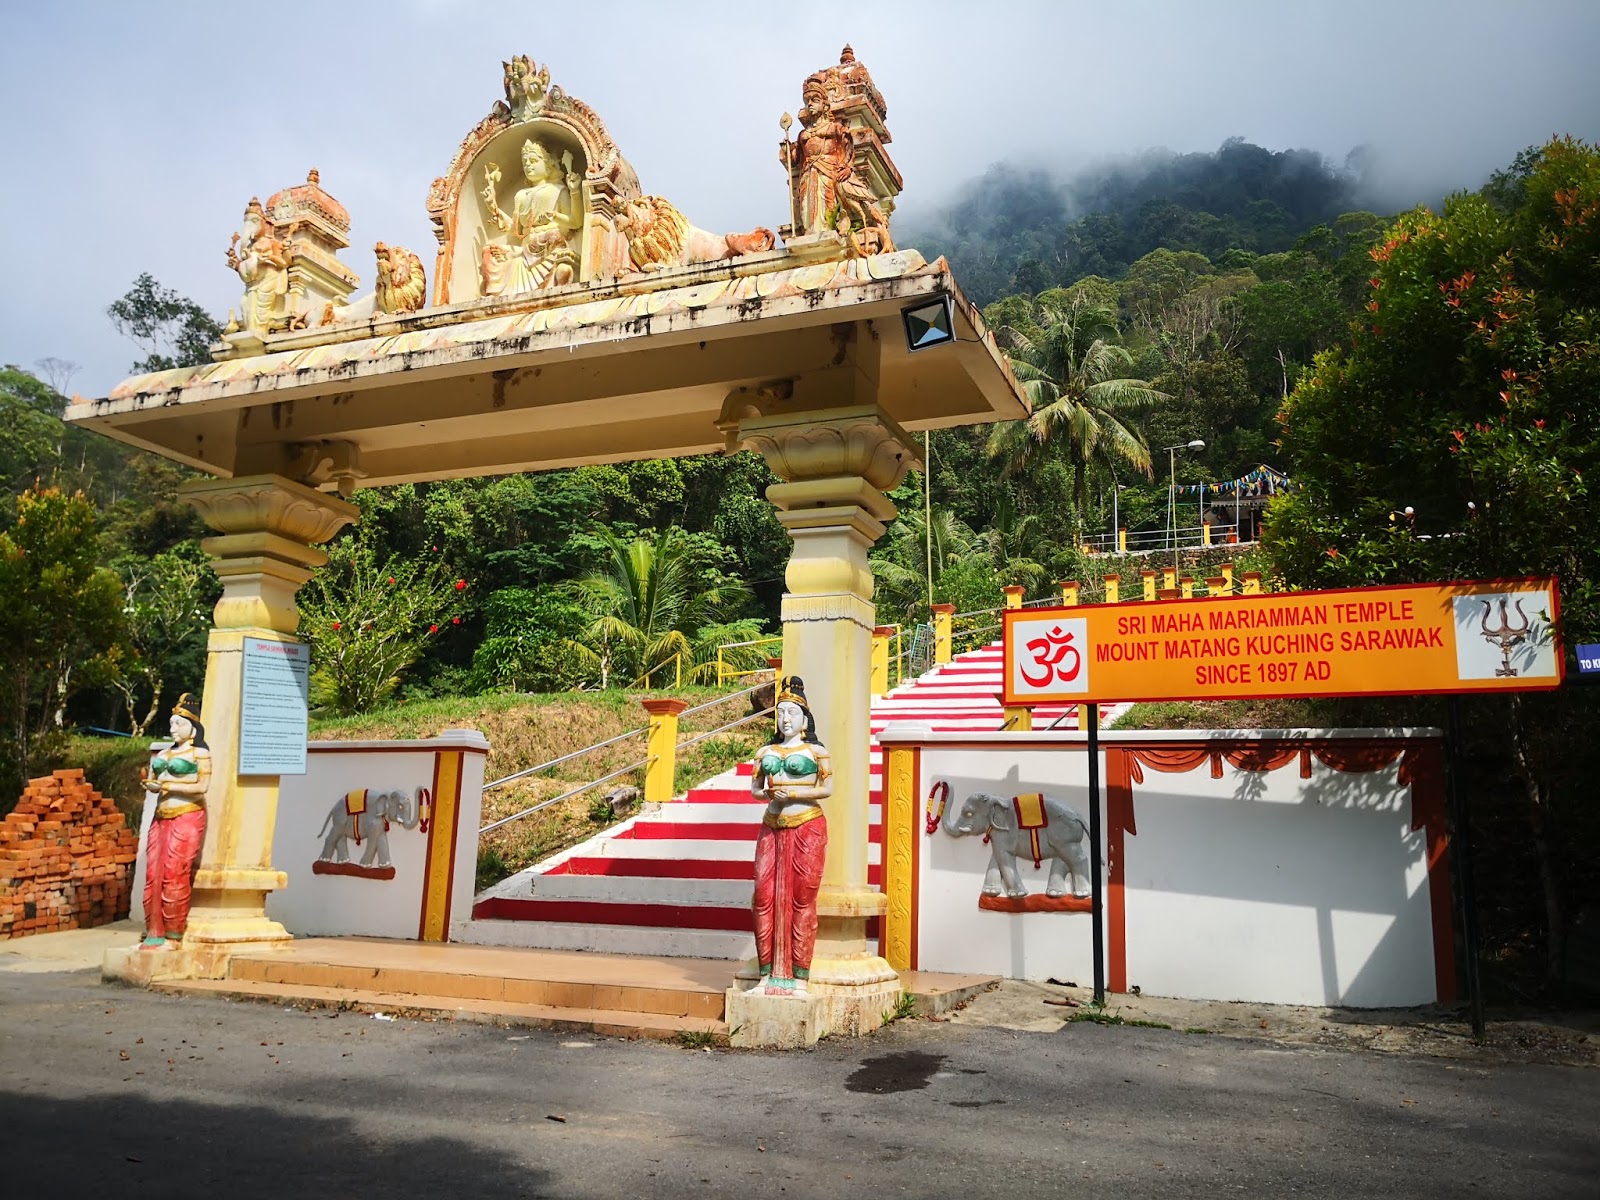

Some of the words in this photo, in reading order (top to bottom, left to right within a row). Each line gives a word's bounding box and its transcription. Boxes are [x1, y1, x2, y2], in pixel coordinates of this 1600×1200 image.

[1117, 615, 1147, 636] SRI
[1151, 612, 1205, 634] MAHA
[1208, 604, 1328, 631] MARIAMMAN
[1332, 599, 1415, 624] TEMPLE
[1096, 640, 1160, 663] MOUNT
[1164, 636, 1241, 660] MATANG
[1246, 632, 1335, 656] KUCHING
[1340, 626, 1445, 652] SARAWAK
[1195, 663, 1252, 686] SINCE
[1257, 661, 1299, 683] 1897
[1303, 660, 1332, 682] AD
[1580, 659, 1592, 669] TO
